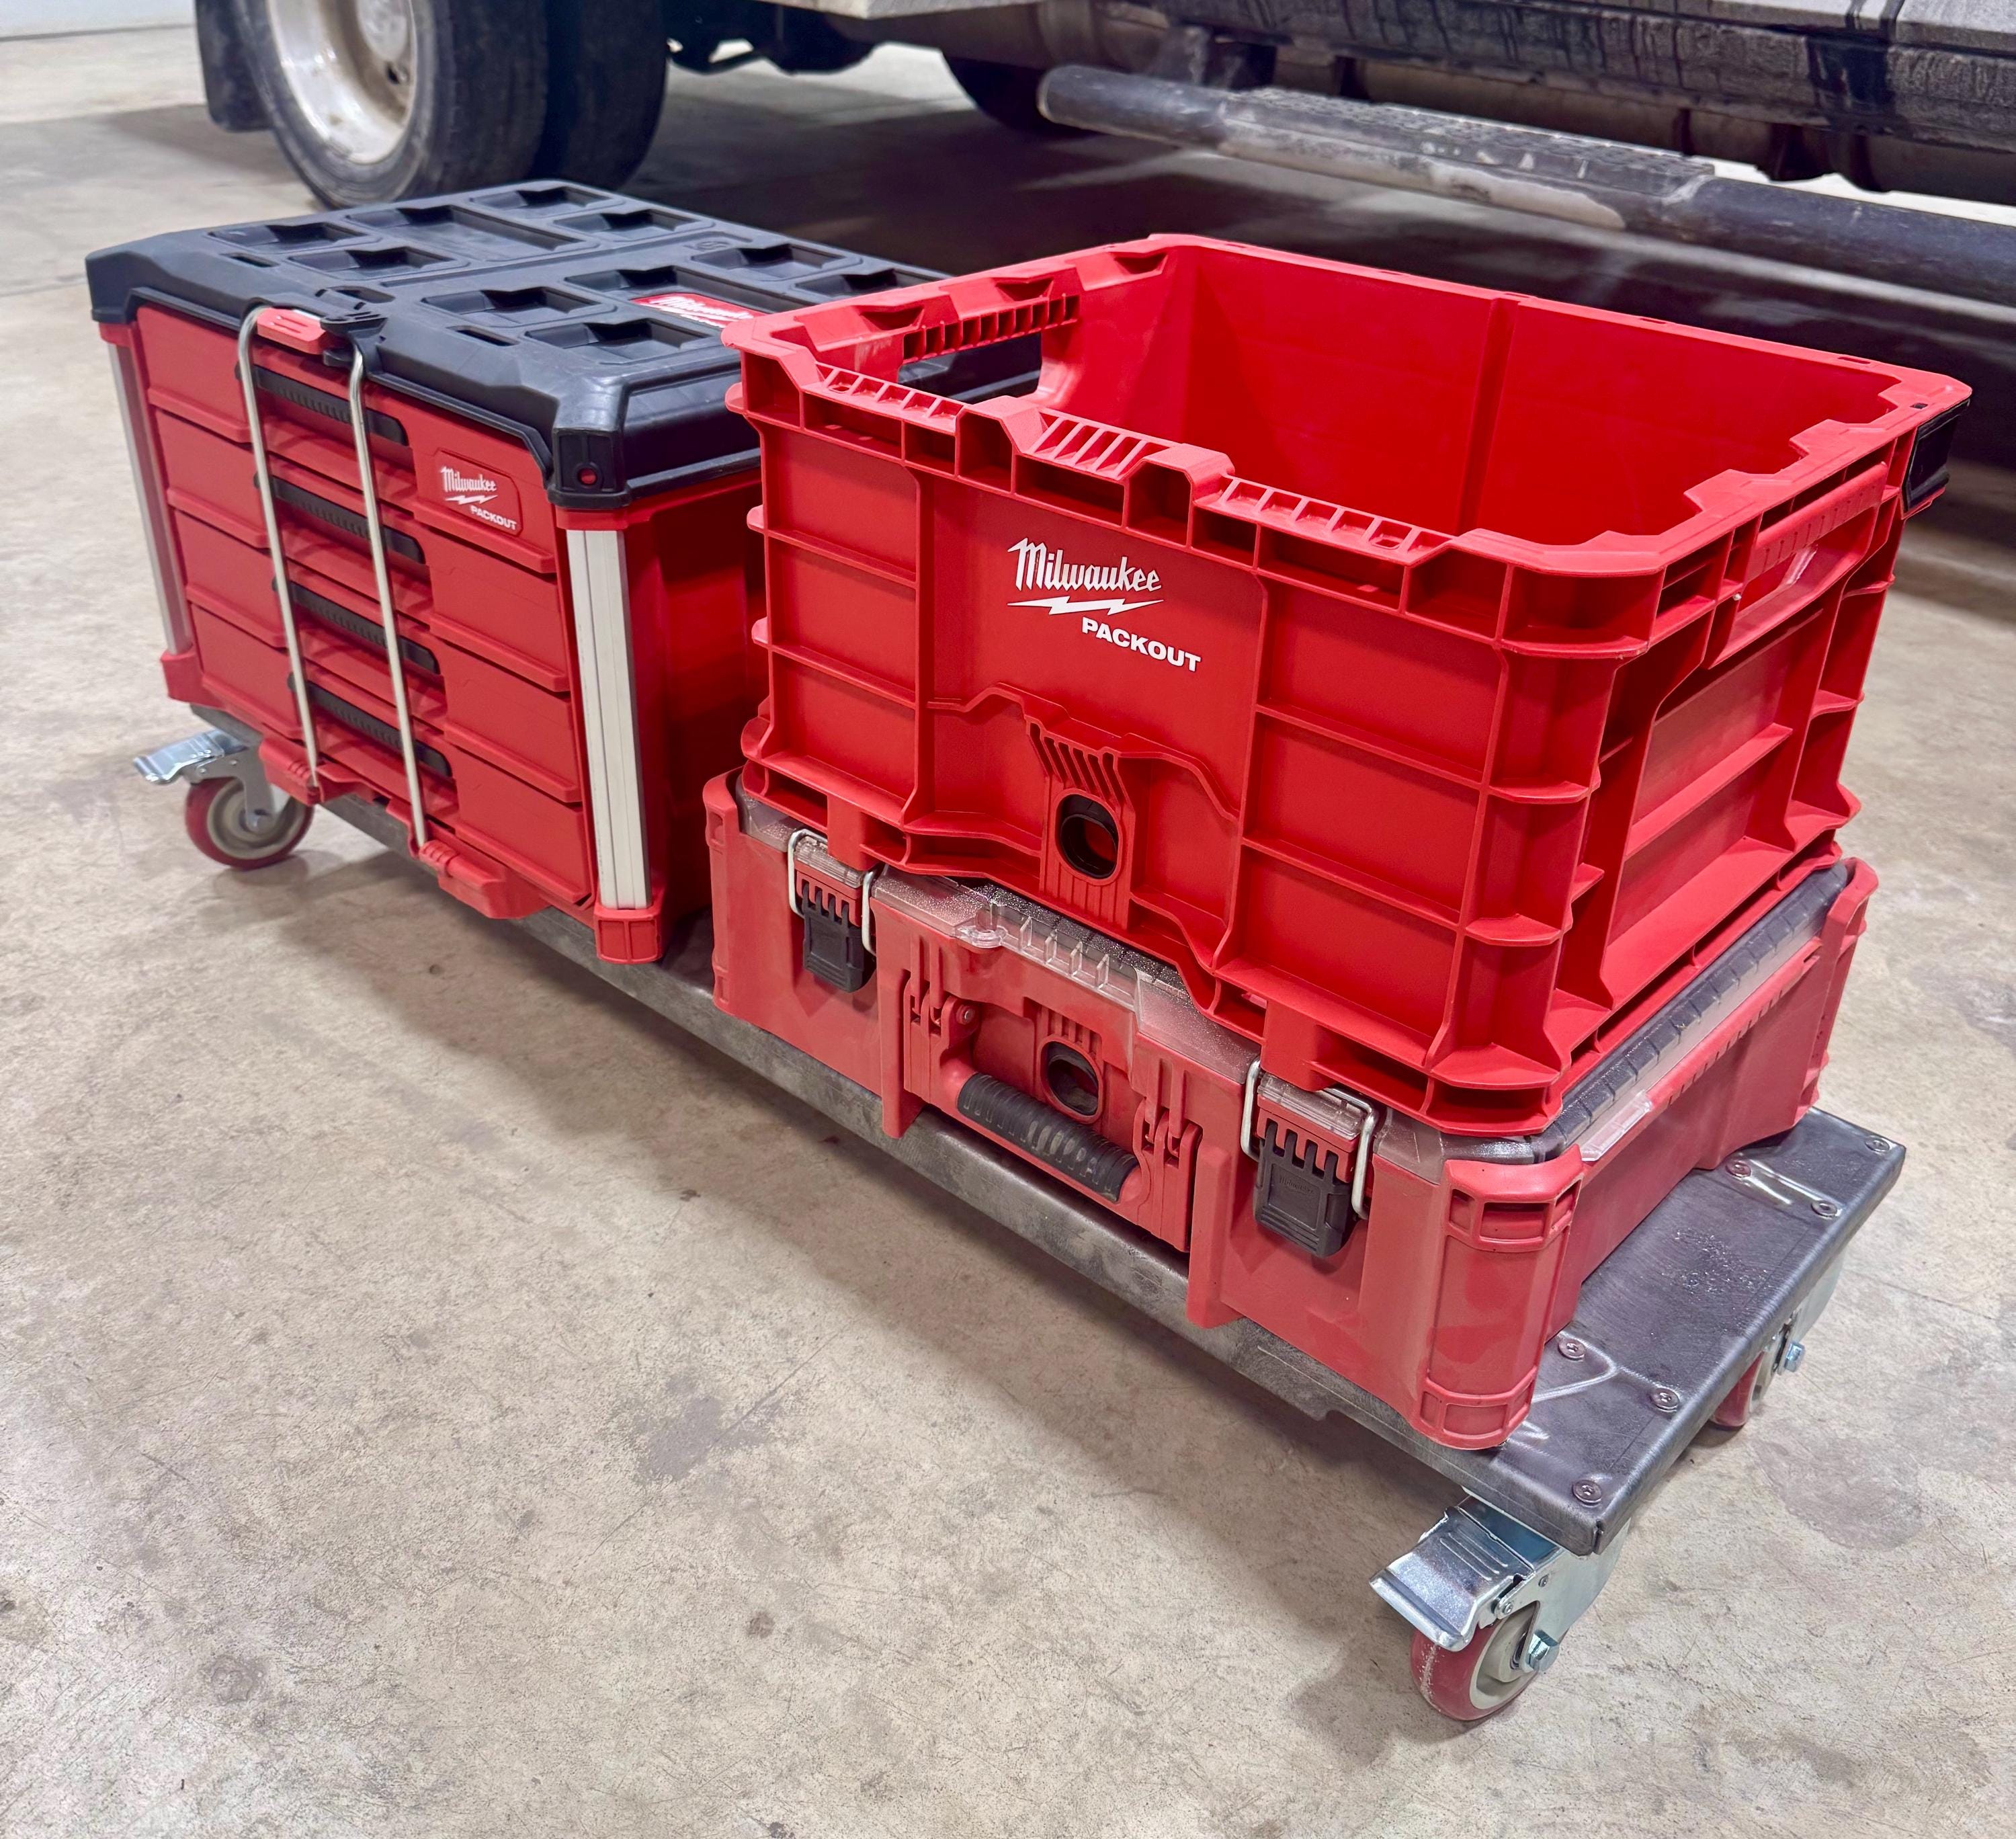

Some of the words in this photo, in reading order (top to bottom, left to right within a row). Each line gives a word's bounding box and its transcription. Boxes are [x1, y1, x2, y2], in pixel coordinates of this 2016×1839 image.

[440, 466, 497, 493] Milwaukee
[470, 505, 517, 530] PACKOUT
[1007, 537, 1162, 592] Milwaukee
[1081, 616, 1202, 672] PACKOUT
